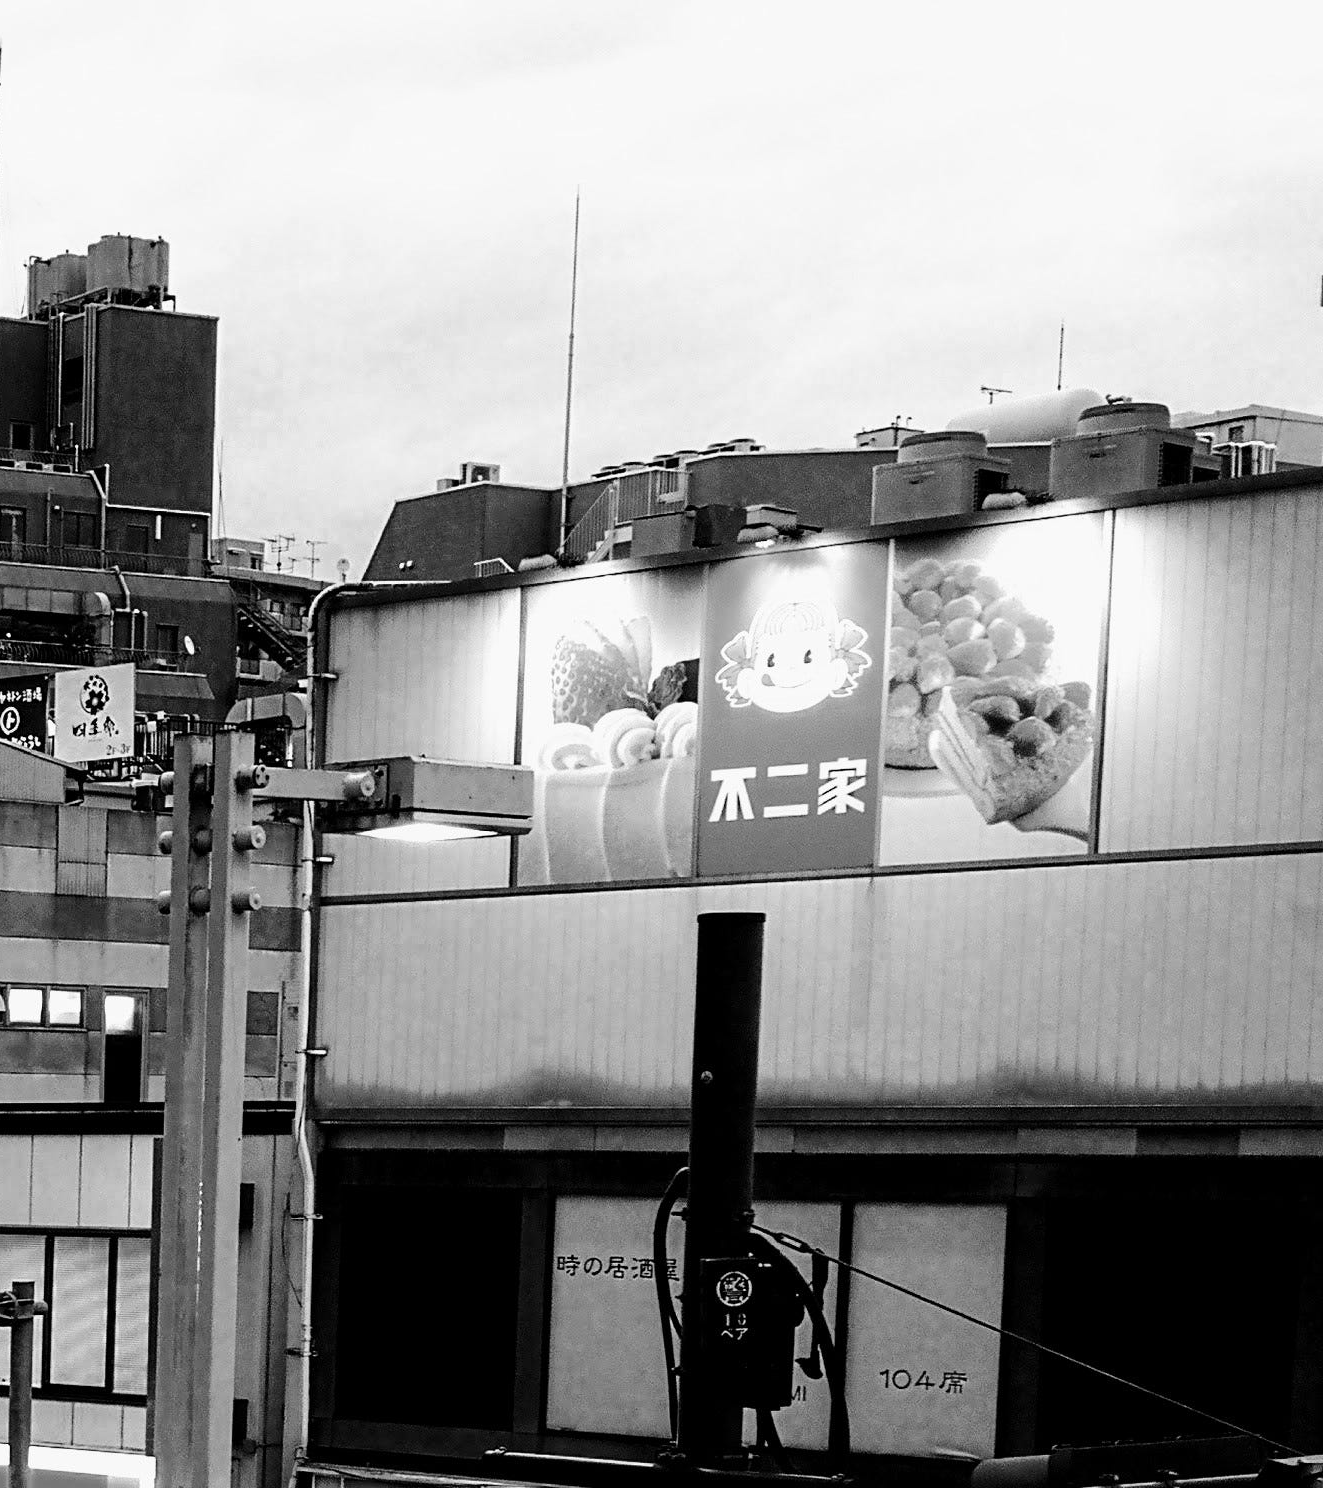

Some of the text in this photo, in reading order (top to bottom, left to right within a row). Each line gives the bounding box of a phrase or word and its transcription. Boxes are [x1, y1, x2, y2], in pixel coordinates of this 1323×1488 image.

[709, 757, 868, 822] 不二家
[879, 1368, 968, 1394] 104席
